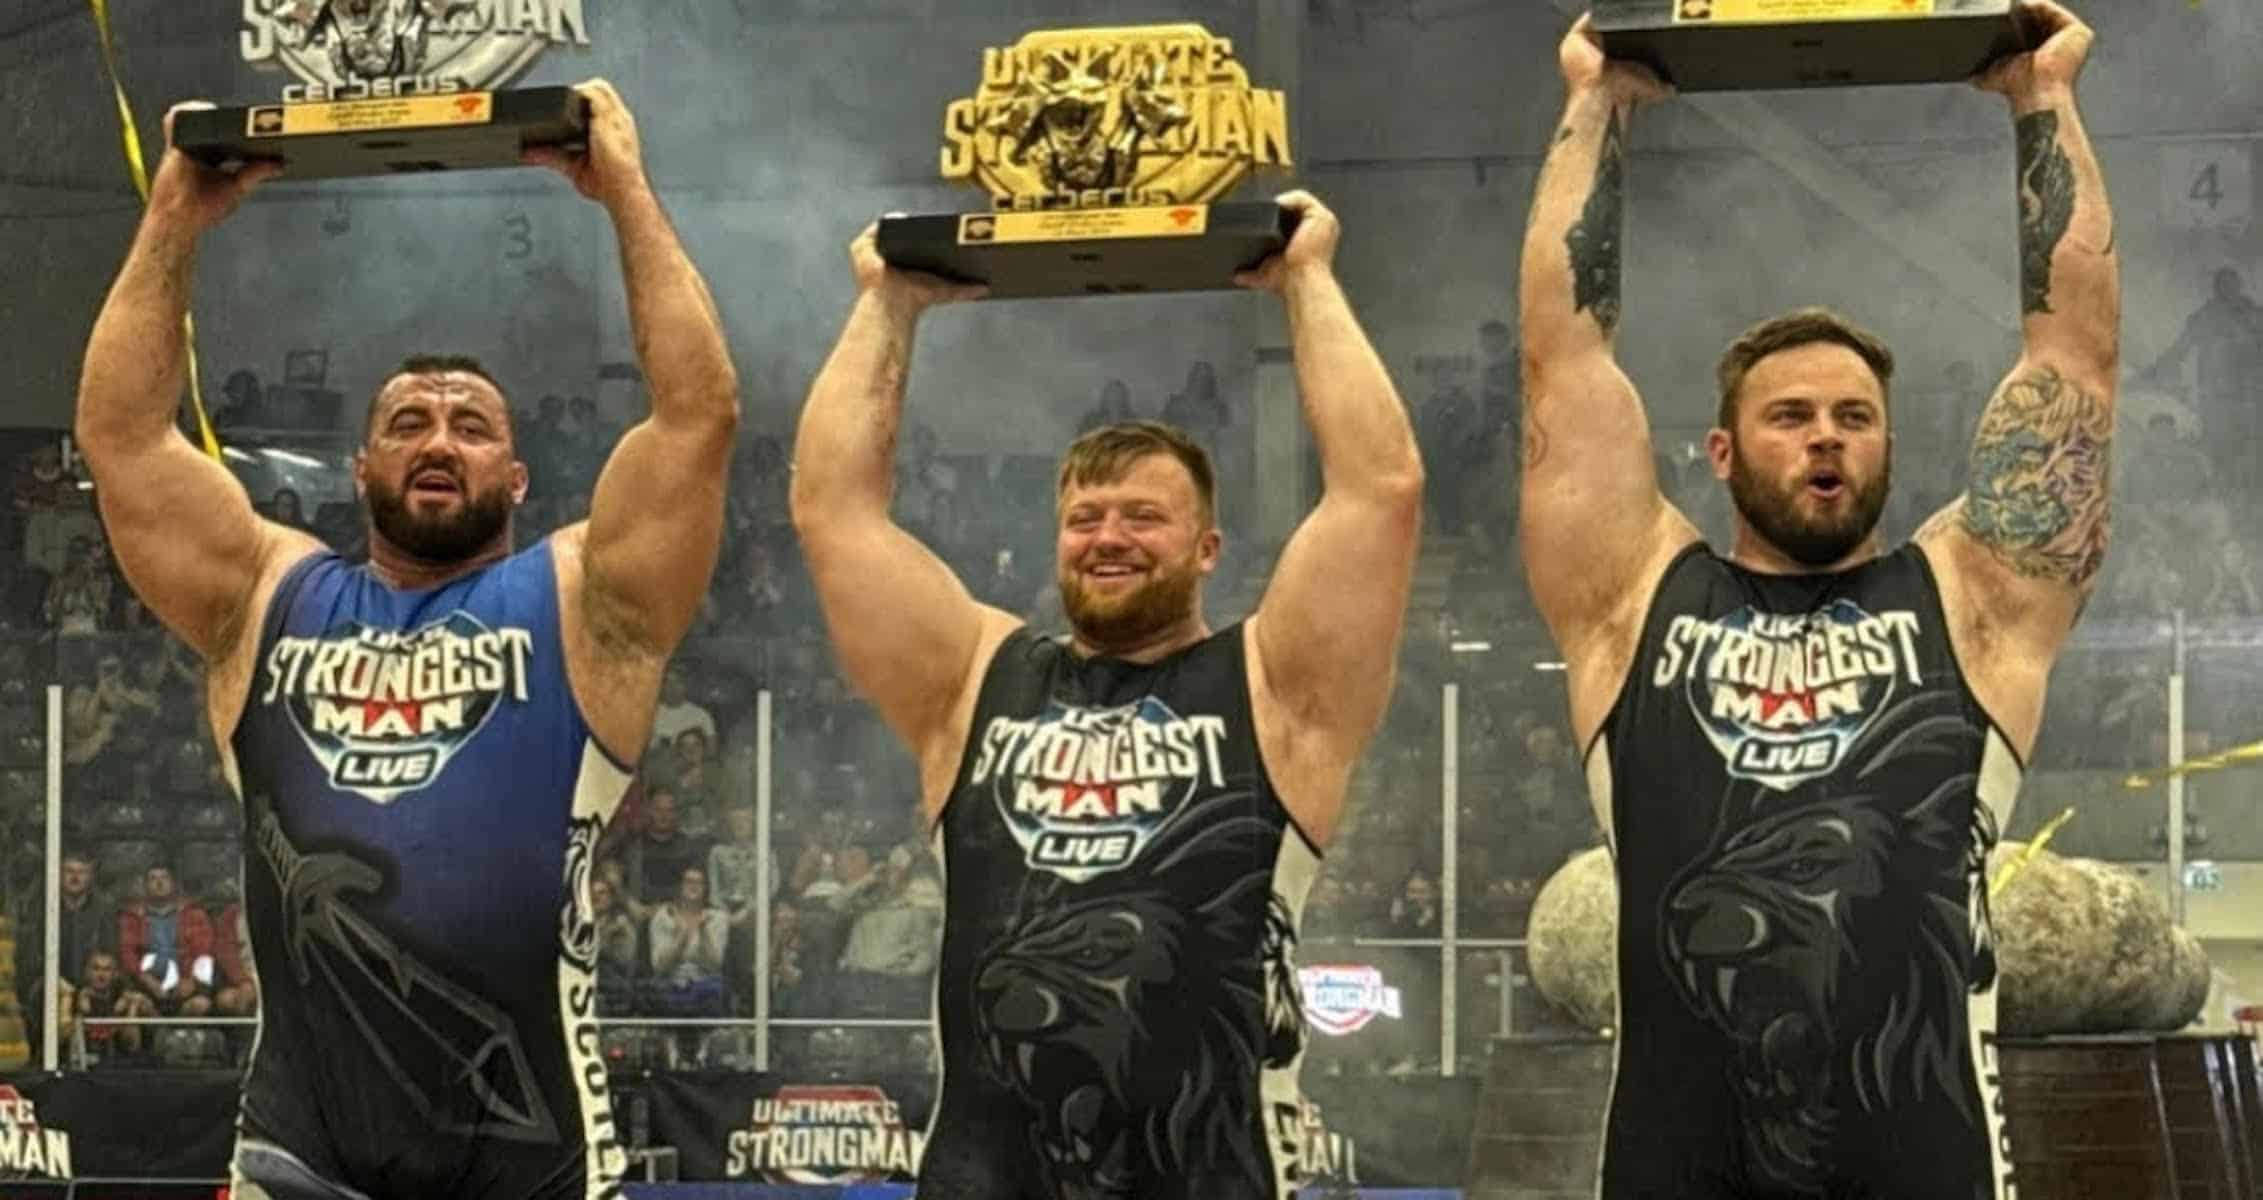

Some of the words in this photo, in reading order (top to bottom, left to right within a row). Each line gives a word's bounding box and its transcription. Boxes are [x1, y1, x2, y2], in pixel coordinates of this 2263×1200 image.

[2189, 161, 2225, 210] 4
[503, 213, 533, 260] 3
[263, 627, 534, 703] STRONGEST
[1653, 610, 1923, 694] STRONGEST
[312, 697, 465, 736] MAN
[1711, 682, 1863, 728] MAN
[342, 752, 429, 784] LIVE
[971, 714, 1227, 788] STRONGEST
[1741, 740, 1832, 770] LIVE
[1014, 780, 1161, 818] MAN
[1037, 834, 1126, 863] LIVE
[752, 1098, 900, 1124] ULTIMATE
